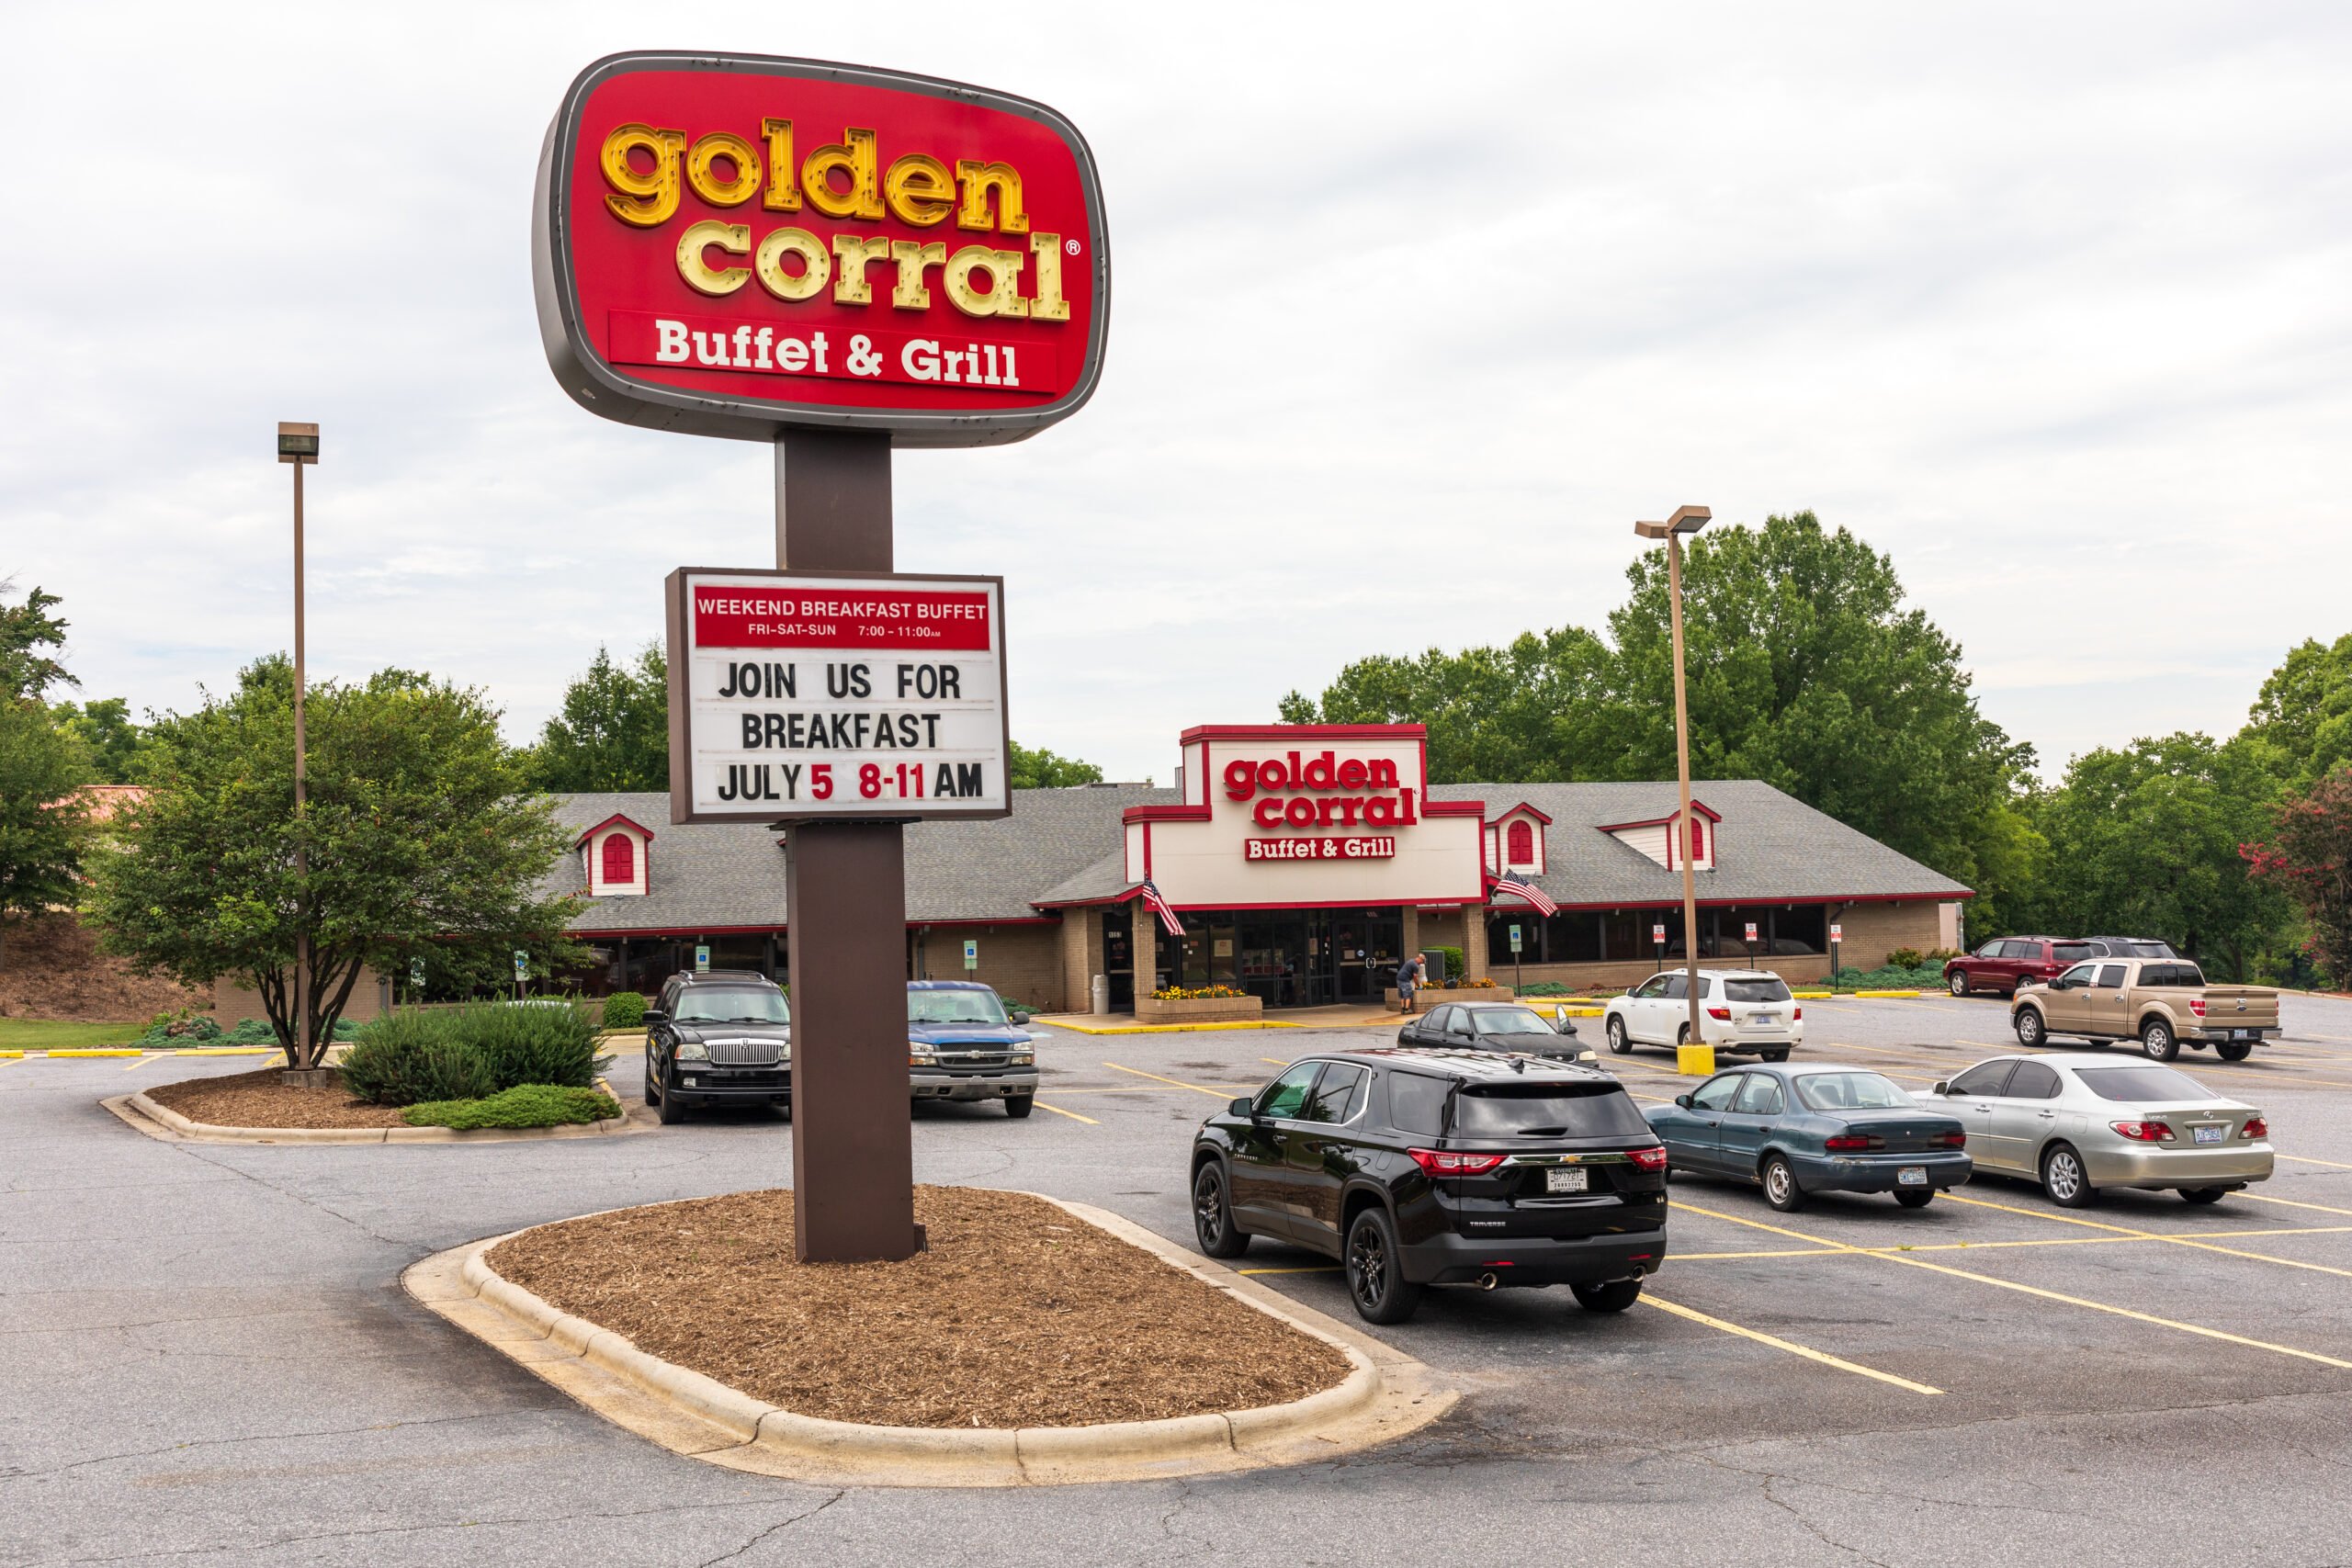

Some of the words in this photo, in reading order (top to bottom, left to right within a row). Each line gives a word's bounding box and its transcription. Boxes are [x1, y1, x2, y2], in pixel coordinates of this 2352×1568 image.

[600, 117, 1030, 234] golden
[675, 220, 1070, 321] corral
[655, 319, 829, 374] Buffet
[845, 334, 883, 378] &
[900, 339, 1020, 387] Grill
[697, 599, 796, 615] WEEKEND
[800, 601, 911, 618] BREAKFAST
[917, 604, 987, 619] BUFFET
[748, 624, 837, 636] FRI-SAT-SUN
[858, 626, 885, 637] 7:00
[718, 662, 797, 698] JOIN
[827, 663, 872, 699] US
[897, 664, 961, 699] FOR
[741, 713, 941, 749] BREAKFAST
[718, 763, 801, 800] JULY
[811, 764, 833, 798] 5
[859, 762, 923, 799] 8-11
[933, 763, 983, 798] AM
[1224, 750, 1400, 802] golden
[1253, 787, 1418, 829] corral
[1249, 840, 1317, 859] Buffet
[1322, 839, 1338, 857] &
[1344, 839, 1394, 856] Grill
